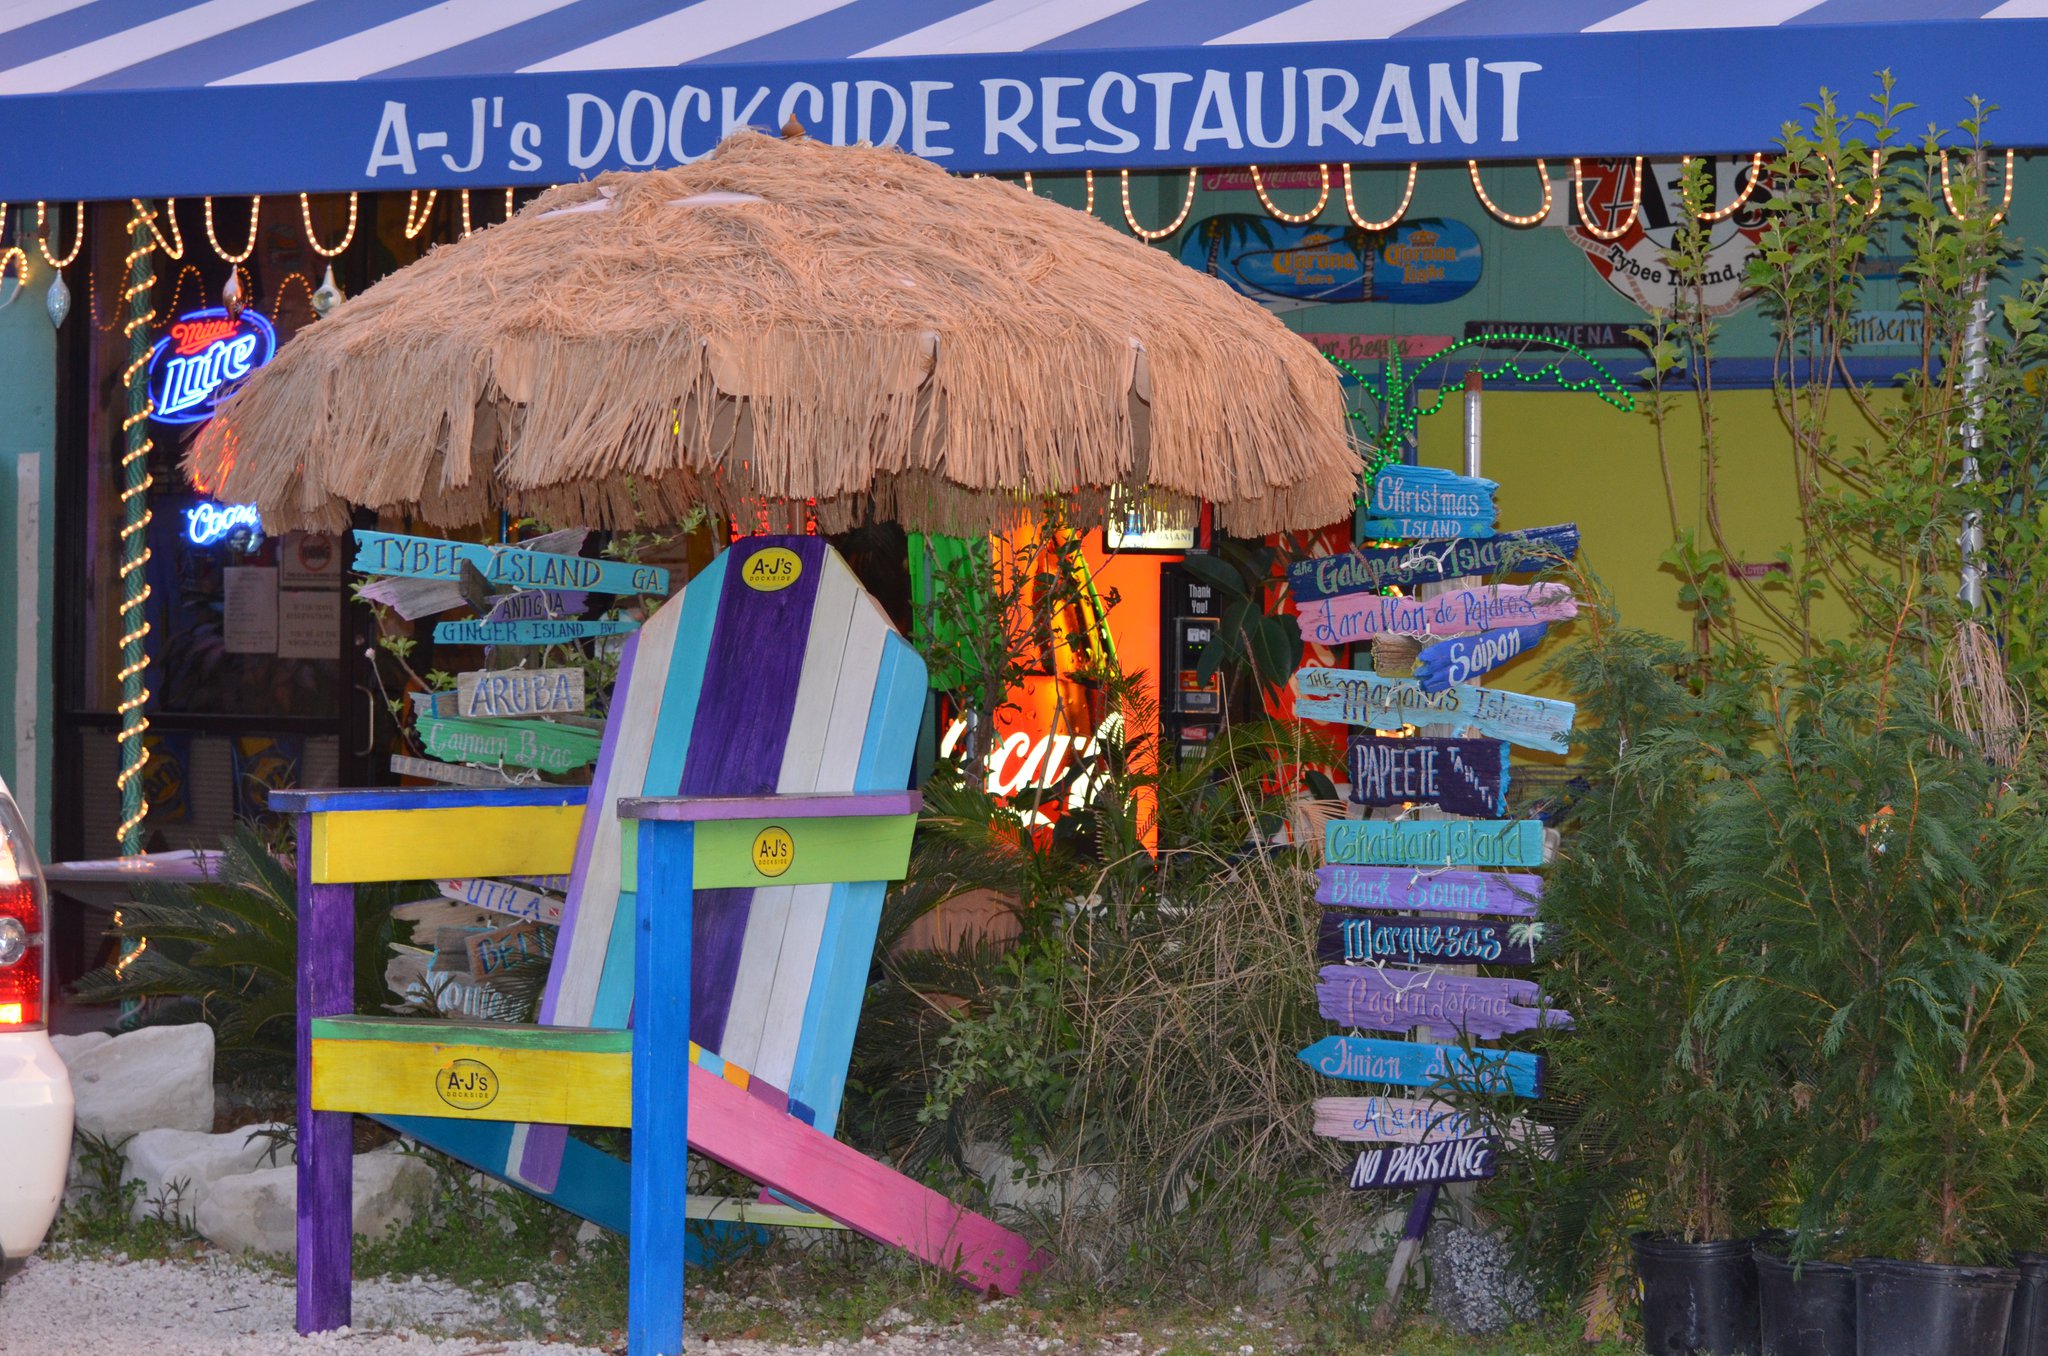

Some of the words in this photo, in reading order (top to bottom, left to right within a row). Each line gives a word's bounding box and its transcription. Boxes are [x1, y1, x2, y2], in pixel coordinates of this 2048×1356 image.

[365, 96, 542, 177] A-J's
[979, 57, 1543, 155] RESTAURANT
[1272, 250, 1358, 277] Corona
[1384, 244, 1456, 267] Corona
[1403, 263, 1445, 284] Light
[1607, 245, 1662, 284] Tybee
[1668, 264, 1742, 287] Iand,
[1295, 272, 1335, 285] Extra
[171, 320, 242, 354] Miller
[158, 334, 257, 416] Lite
[1377, 475, 1480, 517] Christmas
[1400, 518, 1462, 539] ISLAND
[373, 537, 463, 577] TYBEE
[492, 550, 604, 588] ISLAND
[752, 557, 793, 575] A-J's
[1316, 552, 1438, 594] Galapagos
[1445, 538, 1545, 578] Islas
[1189, 583, 1211, 598] Thank
[1191, 599, 1208, 614] You!
[1435, 603, 1457, 624] de
[1457, 591, 1537, 630] Pajaros
[442, 622, 519, 643] GINGER
[532, 623, 585, 640] ISLAND
[467, 672, 574, 717] ARUBA
[1306, 670, 1330, 688] THE
[430, 722, 509, 762] Cayman
[519, 730, 573, 768] Brac
[1355, 744, 1441, 800] PAPEETE
[1446, 746, 1493, 810] TAHITI
[758, 858, 788, 866] DOCKSIDE
[759, 839, 788, 858] A-J's
[1329, 821, 1440, 864] Chatham
[1442, 821, 1525, 864] Island
[466, 879, 541, 920] UTILA
[1330, 869, 1393, 908] Black
[1407, 873, 1489, 910] Sound
[1337, 918, 1502, 964] Marquesas
[1347, 976, 1427, 1026] Pagan
[1430, 981, 1511, 1020] Island
[446, 1091, 489, 1099] DOCKSIDE
[447, 1071, 488, 1091] A-J's
[1353, 1097, 1491, 1141] Alamag
[1350, 1148, 1381, 1188] NO
[1384, 1138, 1489, 1185] PARKING
